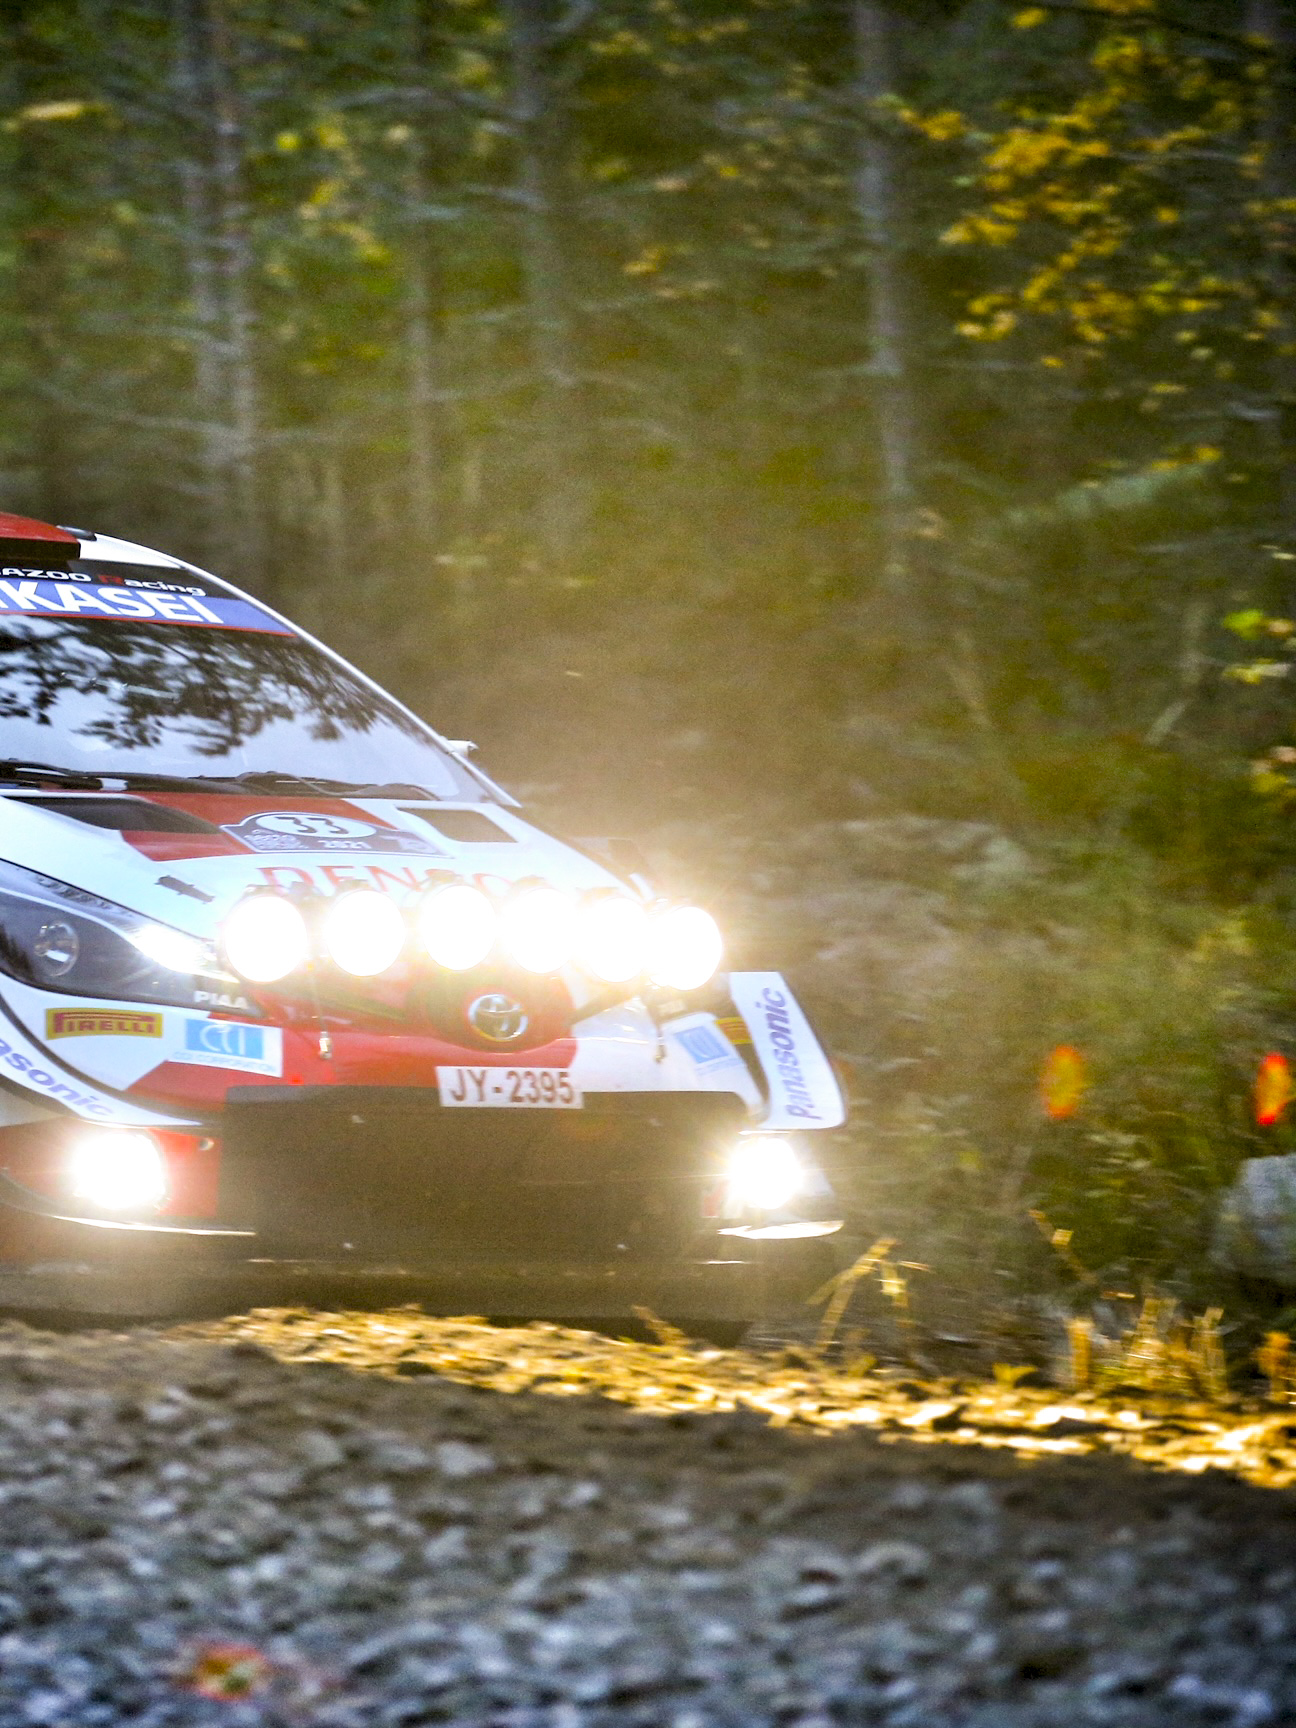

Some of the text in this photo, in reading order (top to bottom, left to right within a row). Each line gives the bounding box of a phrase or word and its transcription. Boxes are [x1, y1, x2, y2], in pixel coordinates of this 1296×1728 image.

[98, 574, 206, 597] Racing
[274, 816, 350, 835] 33
[256, 865, 516, 894] DENO
[54, 1012, 156, 1034] PIRELLI
[450, 1068, 575, 1105] JY-2395
